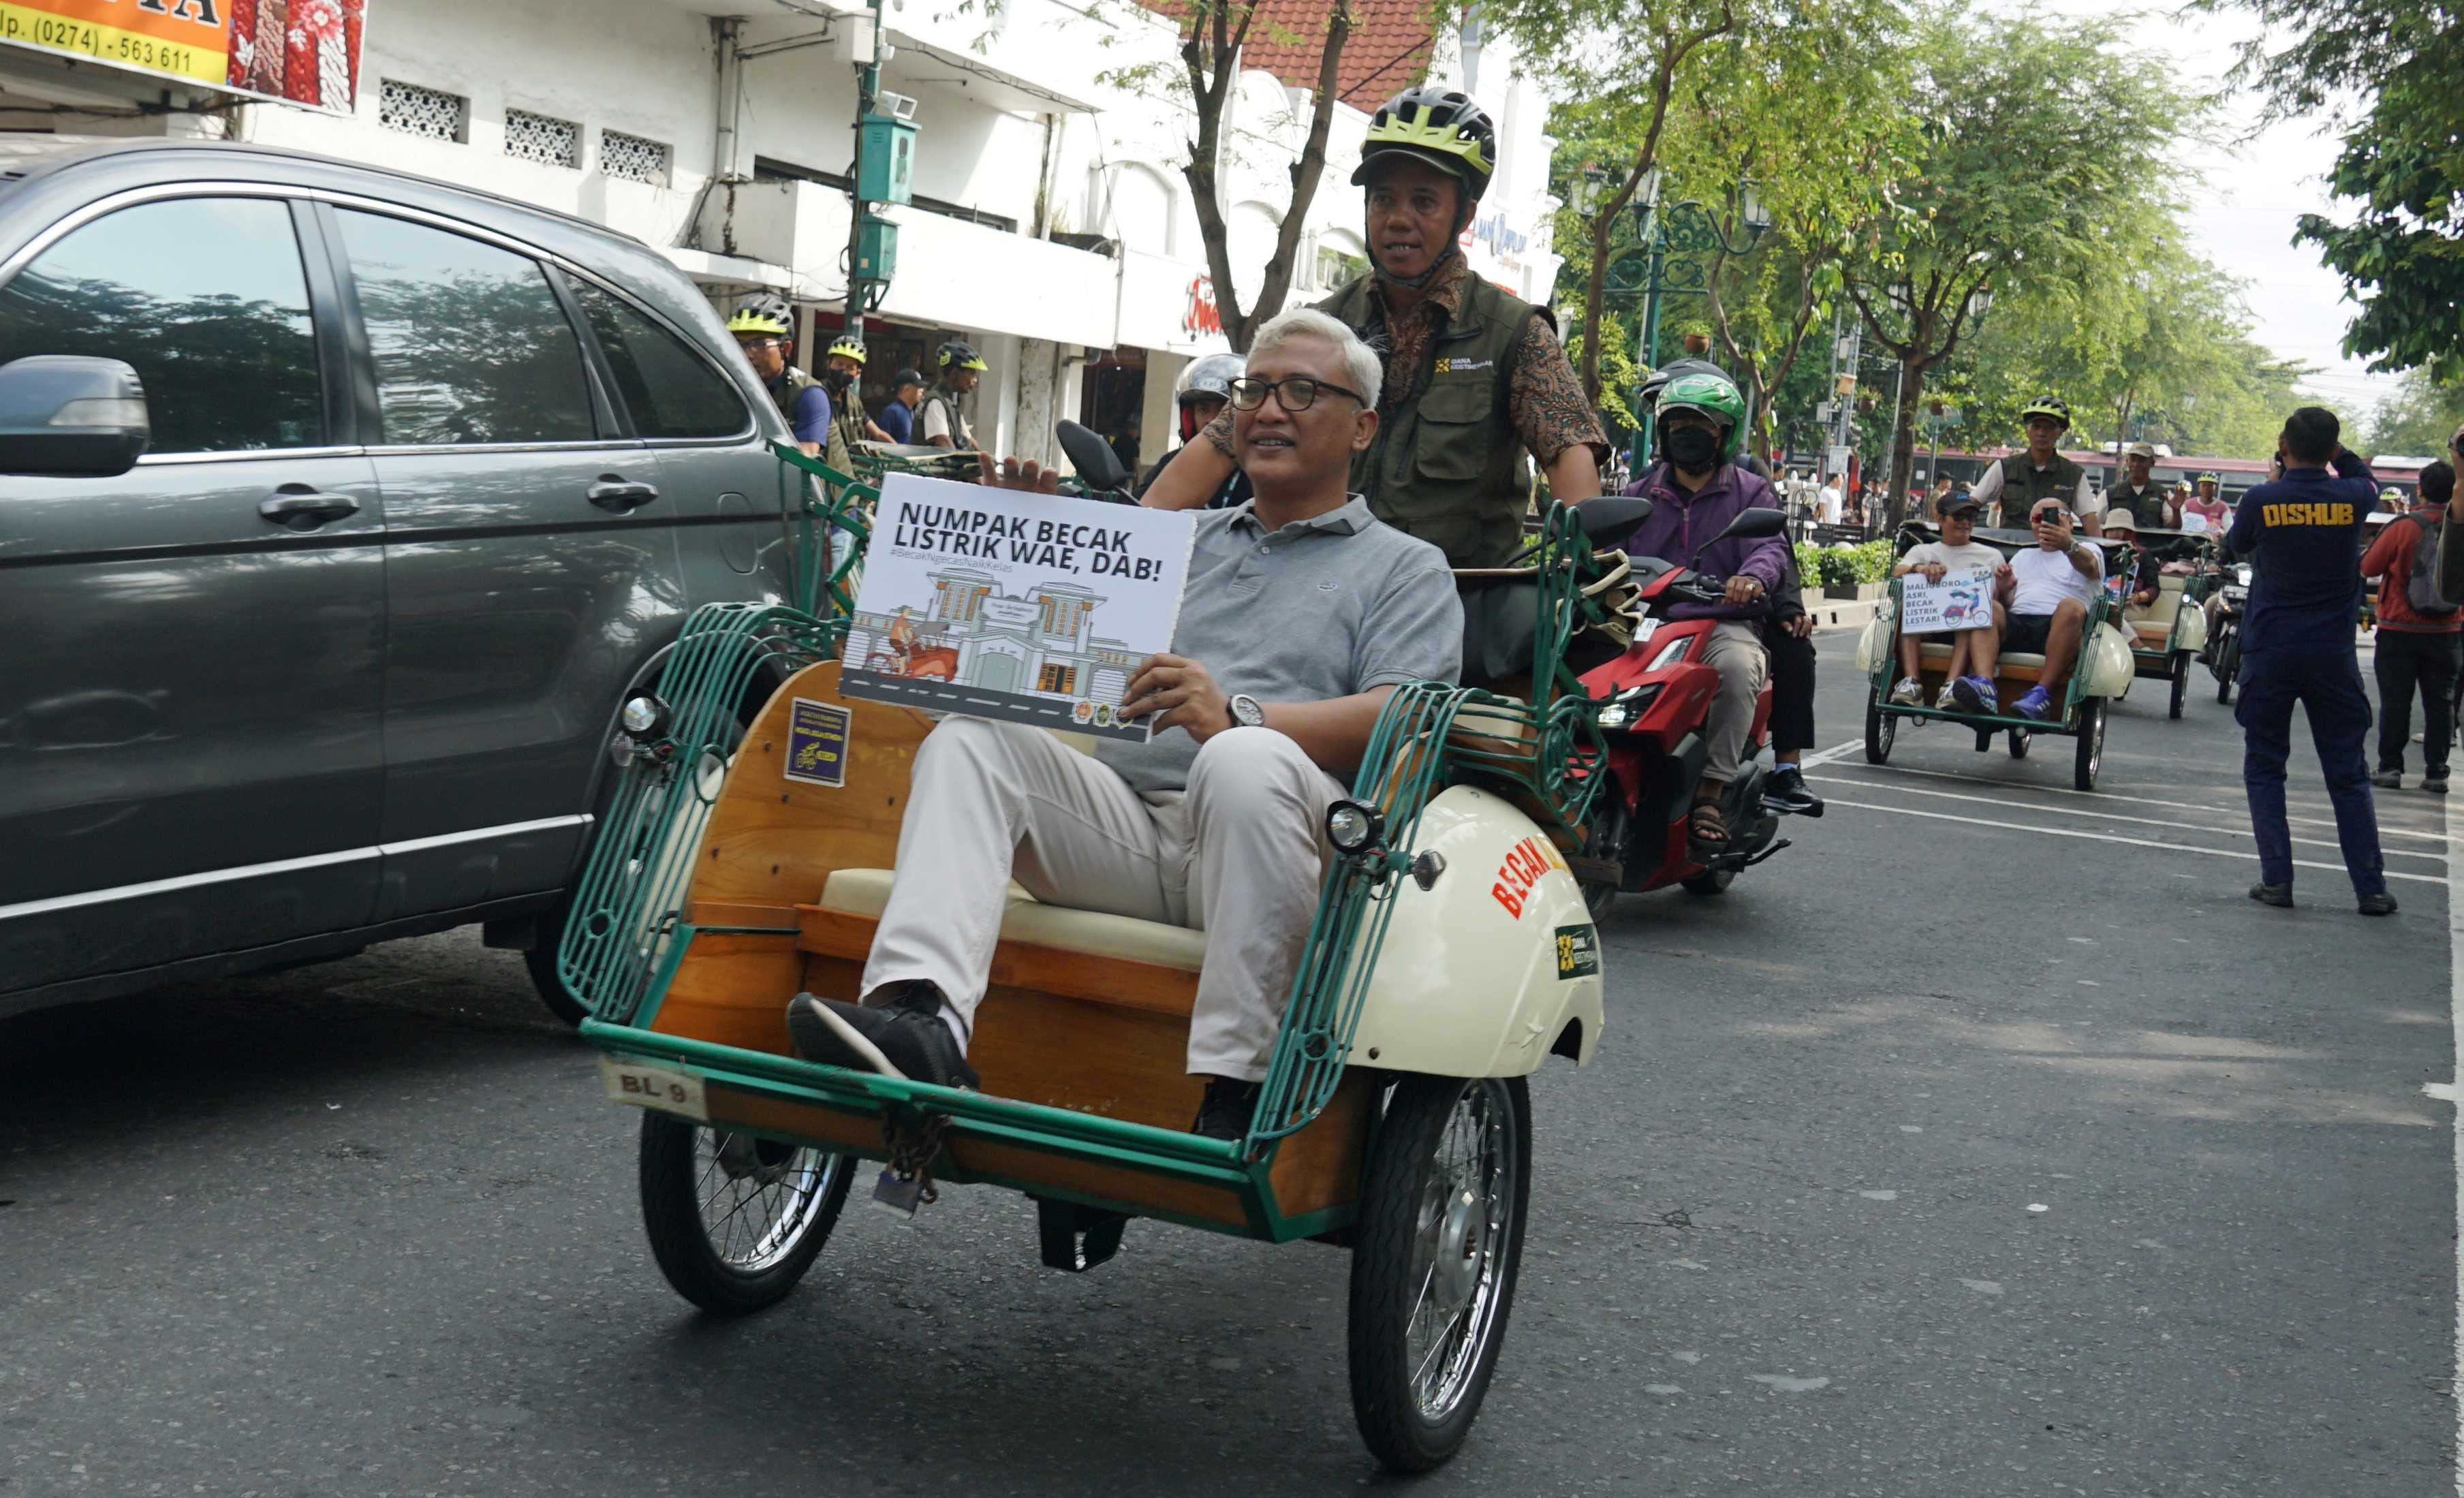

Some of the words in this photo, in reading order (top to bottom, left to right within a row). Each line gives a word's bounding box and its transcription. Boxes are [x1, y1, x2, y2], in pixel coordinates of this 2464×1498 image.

[35, 16, 99, 57] (0274)
[120, 37, 153, 63] 563
[161, 47, 191, 72] 611
[899, 502, 1029, 540] NUMPAK
[1035, 520, 1133, 554] BECAK
[2262, 503, 2354, 527] DISHUB
[894, 525, 1005, 559] LISTRIK
[1010, 540, 1081, 575] WAE,
[1091, 551, 1163, 582] DAB!
[1906, 591, 1929, 599] ASRI,
[1906, 599, 1934, 608] BECAK
[1905, 607, 1938, 617] LISTRIK
[1905, 615, 1940, 625] LESTARI
[1492, 837, 1550, 920] BECAK
[621, 1074, 661, 1097] BL
[669, 1082, 687, 1103] 9
